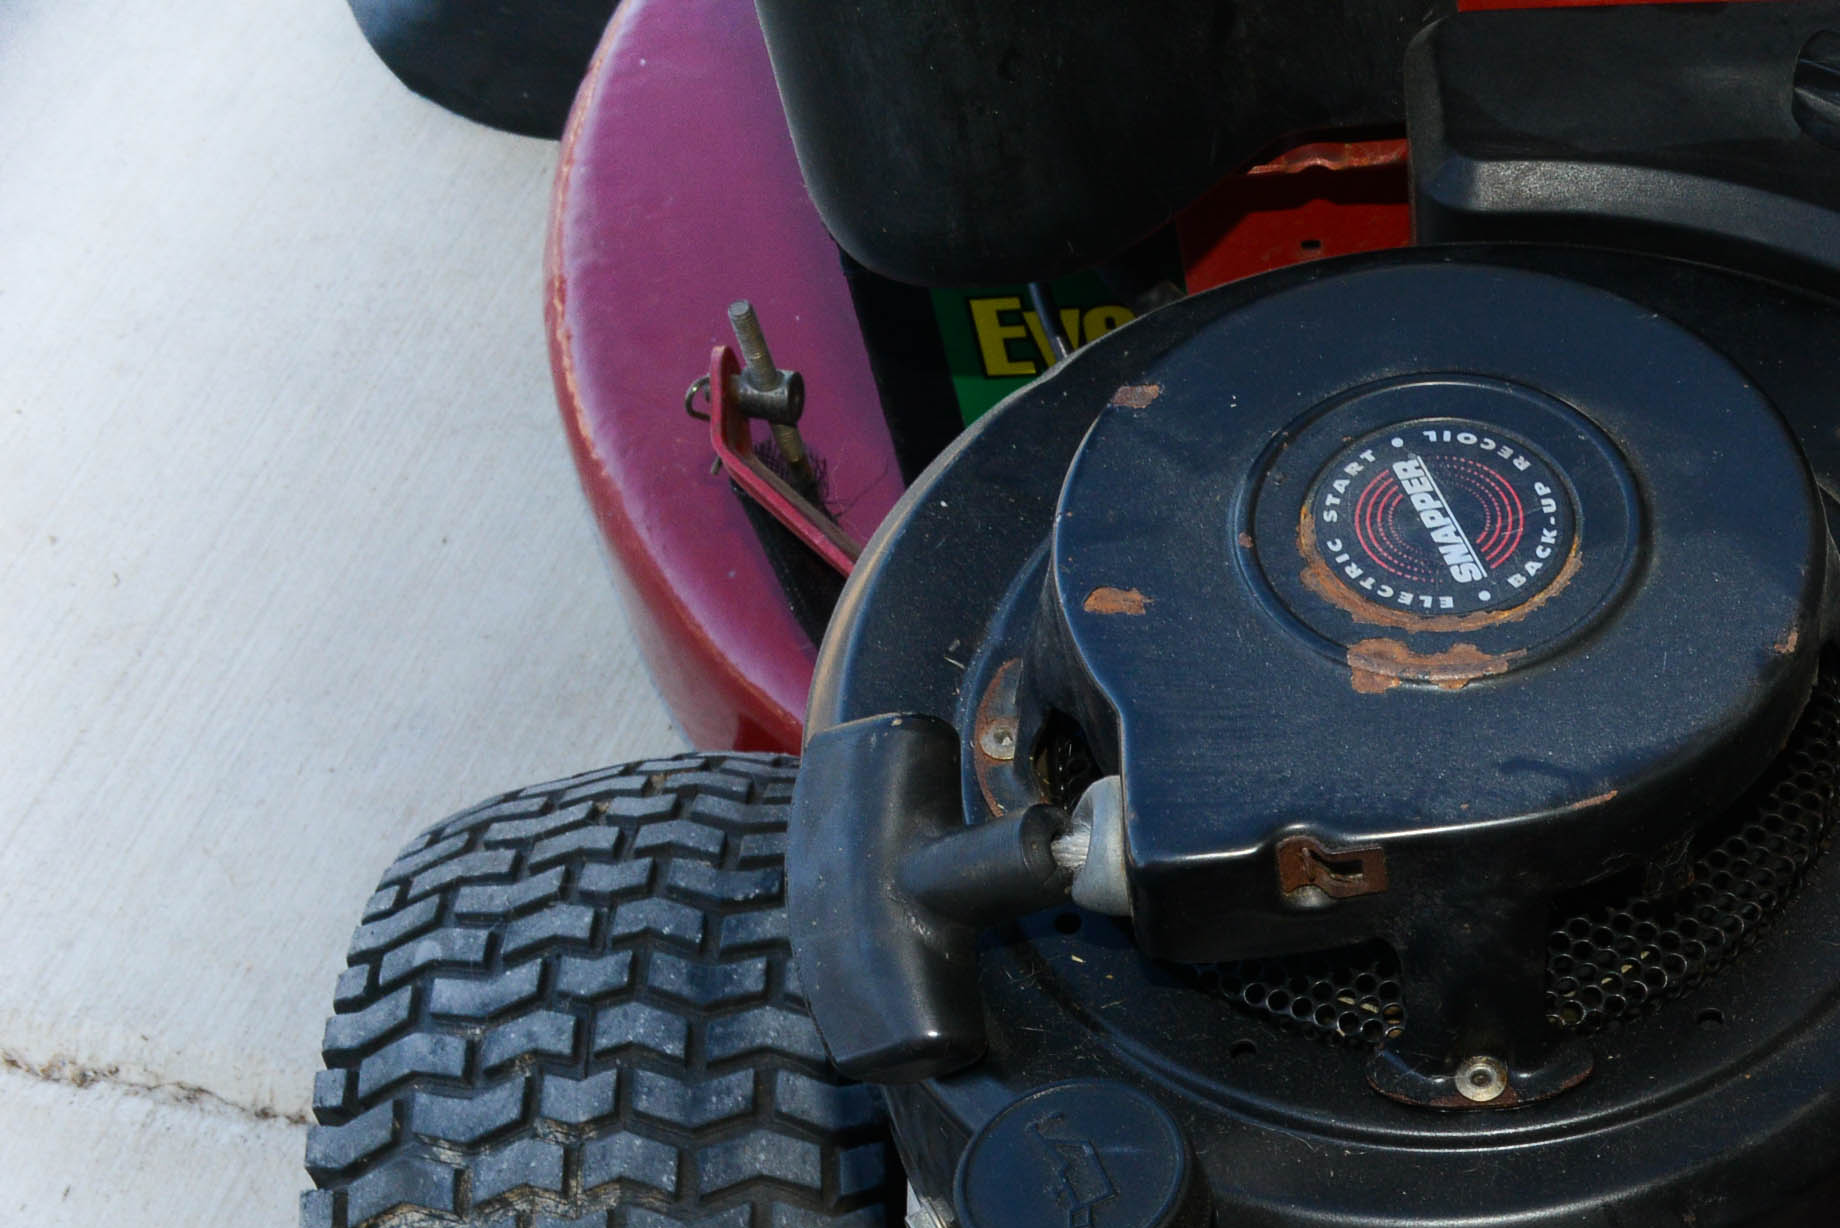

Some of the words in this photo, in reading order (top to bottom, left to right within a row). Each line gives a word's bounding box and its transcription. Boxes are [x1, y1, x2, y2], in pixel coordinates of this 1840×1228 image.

[1323, 449, 1376, 523] START
[1423, 430, 1531, 472] RECOIL
[1392, 458, 1483, 583] SNAPPER
[1507, 482, 1557, 588] BACK-UP
[1326, 538, 1454, 609] ELECTRIC
